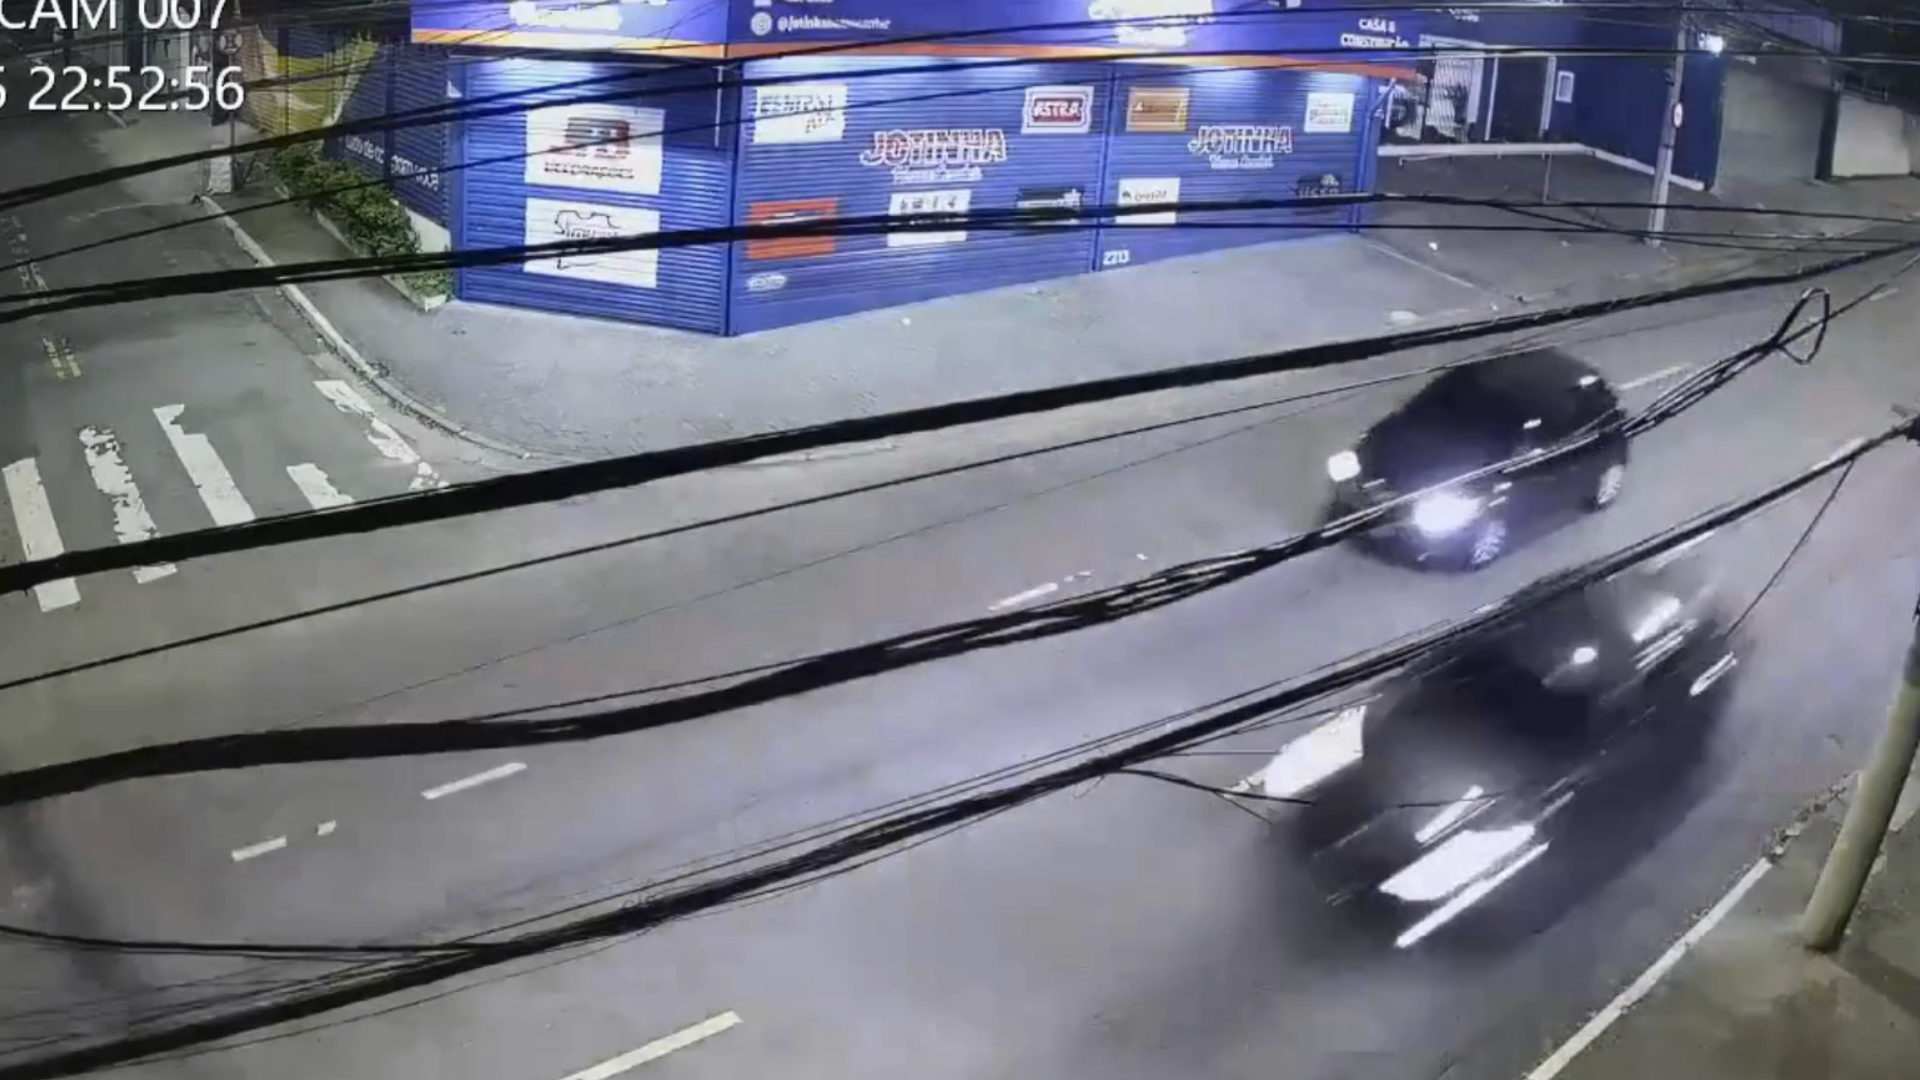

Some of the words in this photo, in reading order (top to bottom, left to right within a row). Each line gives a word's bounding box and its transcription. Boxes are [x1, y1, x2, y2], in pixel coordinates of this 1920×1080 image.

[1033, 100, 1080, 118] ASTRA
[859, 129, 1007, 166] JOTINHA
[1187, 125, 1293, 156] JOTINHA
